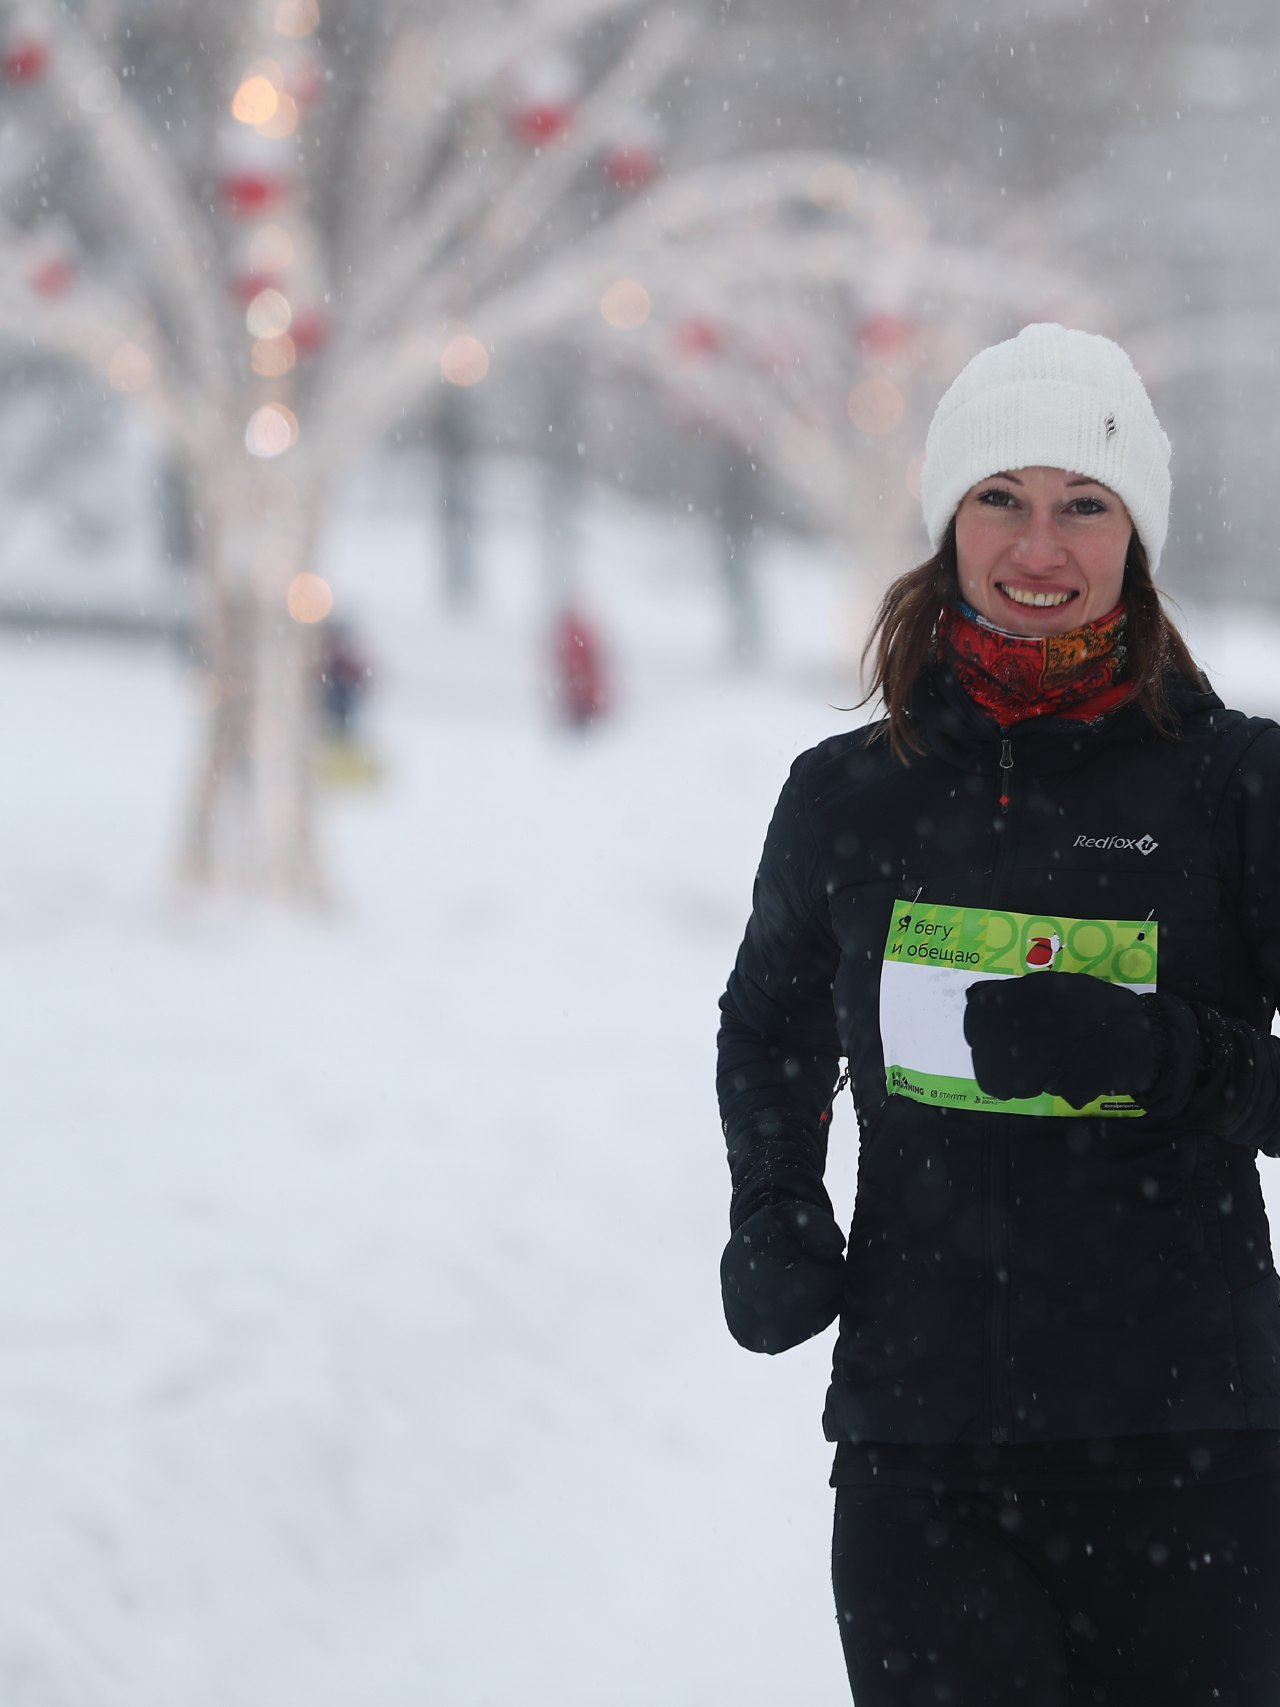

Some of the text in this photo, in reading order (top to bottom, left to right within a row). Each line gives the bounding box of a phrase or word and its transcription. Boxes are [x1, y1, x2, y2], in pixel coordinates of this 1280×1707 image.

[1073, 835, 1136, 850] Redfox
[897, 917, 954, 942] Я бегу
[892, 942, 980, 964] и обещаю
